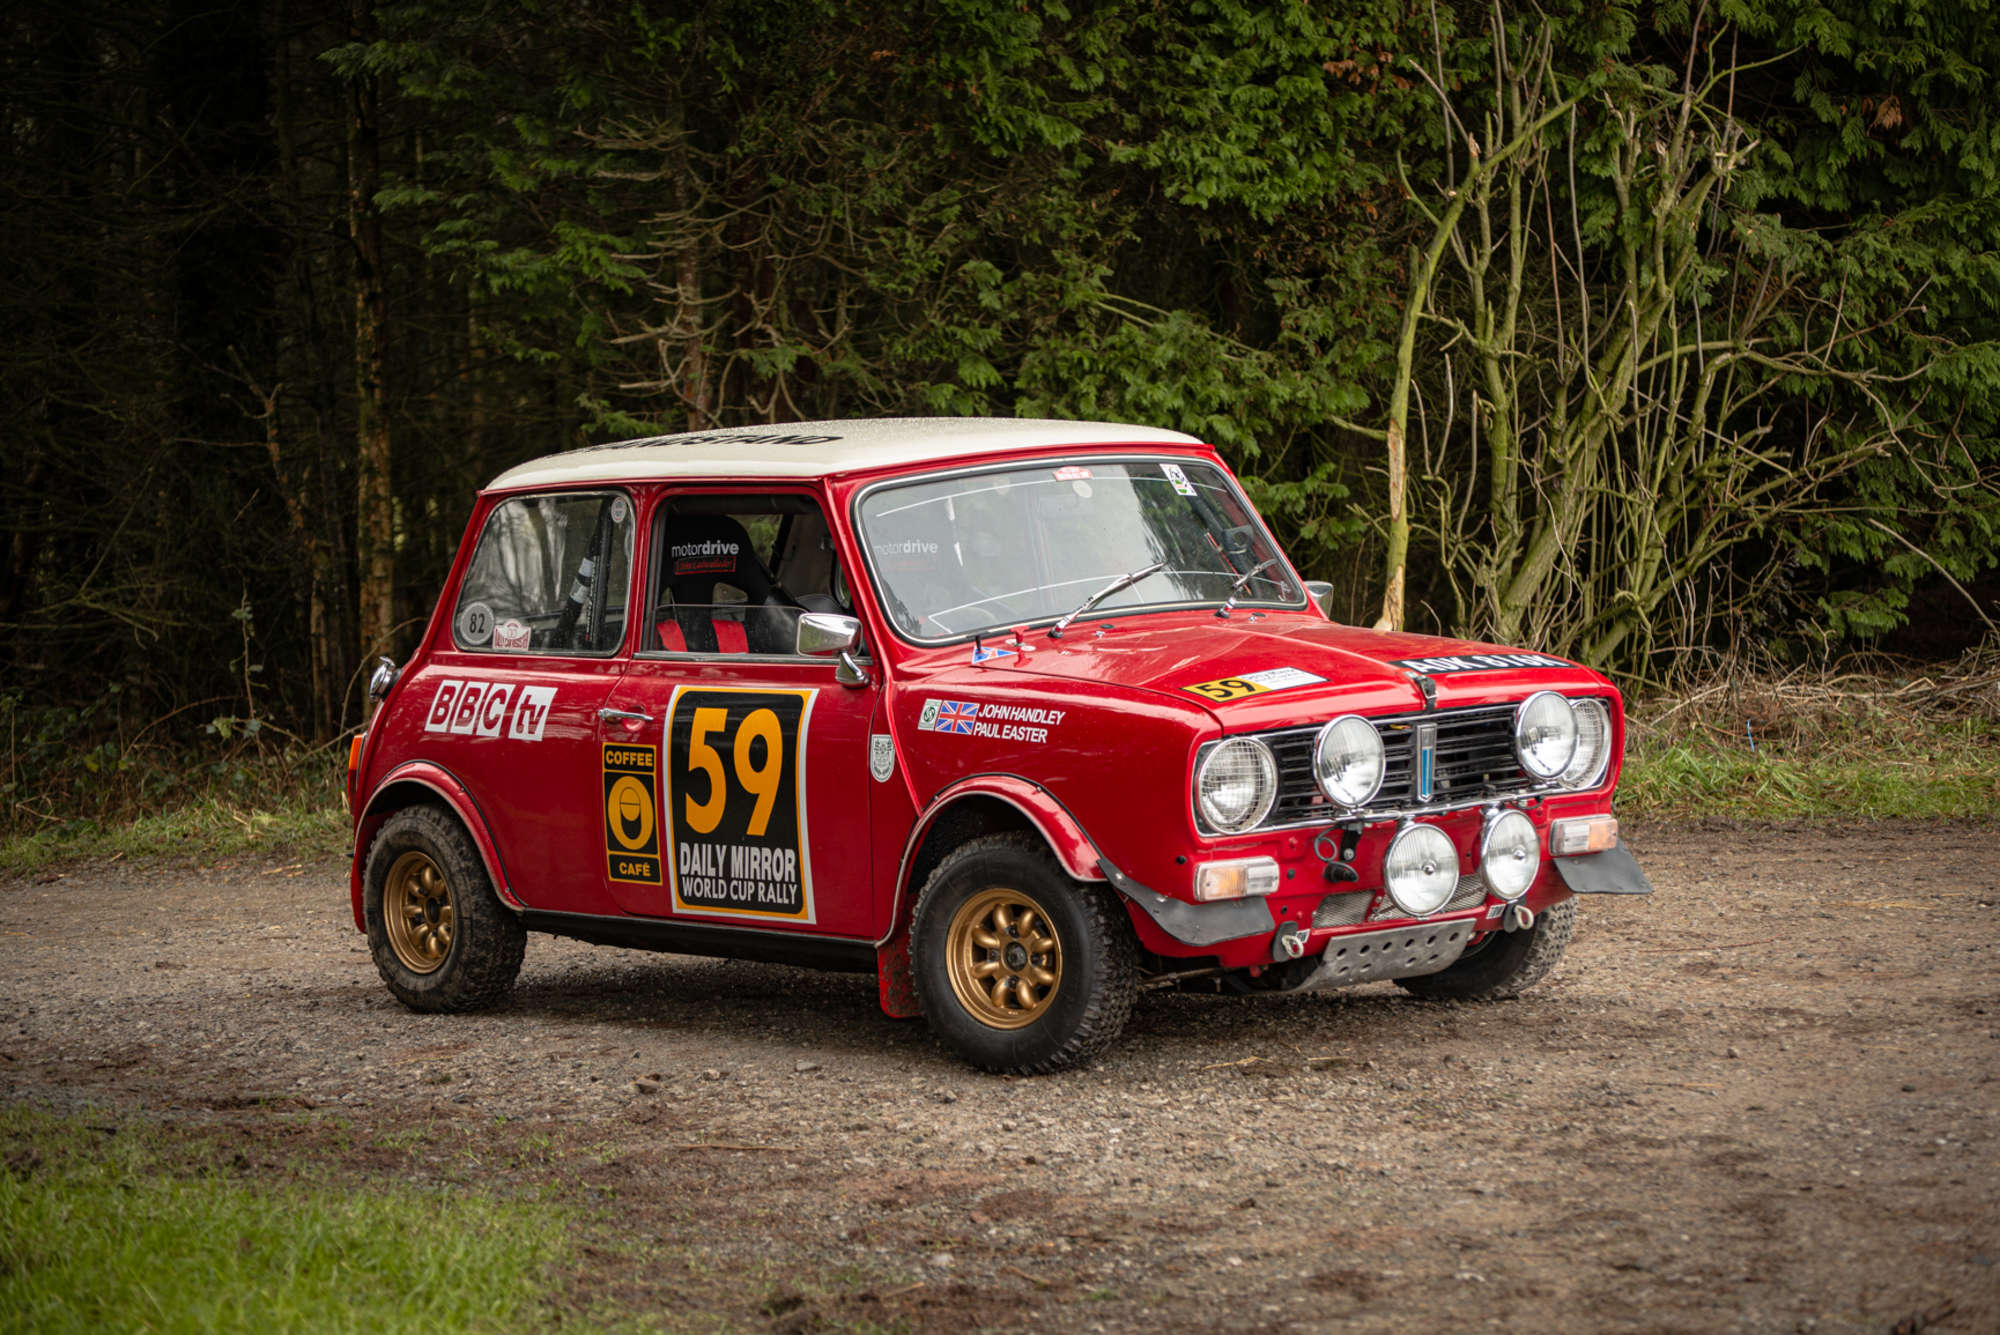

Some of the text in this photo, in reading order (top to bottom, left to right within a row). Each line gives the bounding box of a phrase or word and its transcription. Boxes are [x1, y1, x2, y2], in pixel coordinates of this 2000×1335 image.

[672, 540, 739, 557] motordrive
[469, 613, 486, 634] 82
[1195, 679, 1256, 698] 59
[428, 683, 511, 732] BBC
[978, 703, 1066, 725] JOHN HANDLEY
[973, 722, 1049, 743] PAUL EASTER
[605, 750, 653, 767] COFFEE
[685, 707, 783, 836] 59
[619, 861, 651, 877] CAFÉ
[680, 842, 796, 883] DAILY MIRROR
[682, 876, 798, 905] WORLD CUP RALLY
